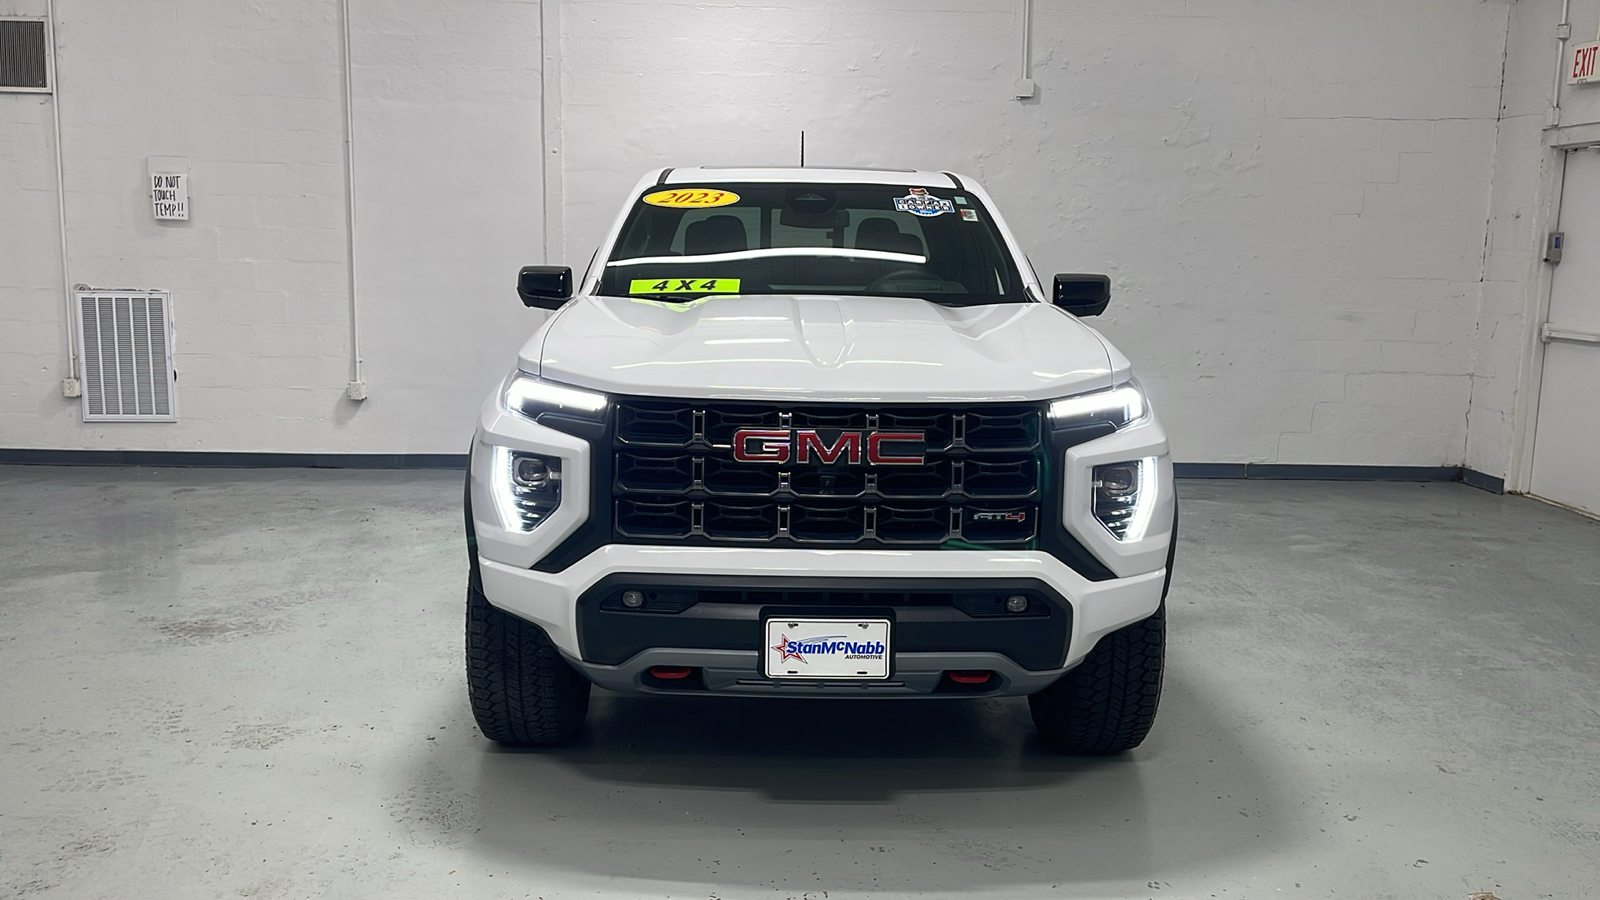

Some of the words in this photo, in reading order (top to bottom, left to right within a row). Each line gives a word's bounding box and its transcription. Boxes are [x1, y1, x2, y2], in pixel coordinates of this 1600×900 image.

[1573, 46, 1598, 78] EXIT
[154, 176, 162, 188] DO
[165, 176, 181, 189] NOT
[153, 189, 175, 201] TOUCH
[657, 192, 724, 204] 2023
[155, 202, 184, 217] TEMP!!
[733, 429, 925, 466] GMC
[973, 512, 1026, 522] AT4
